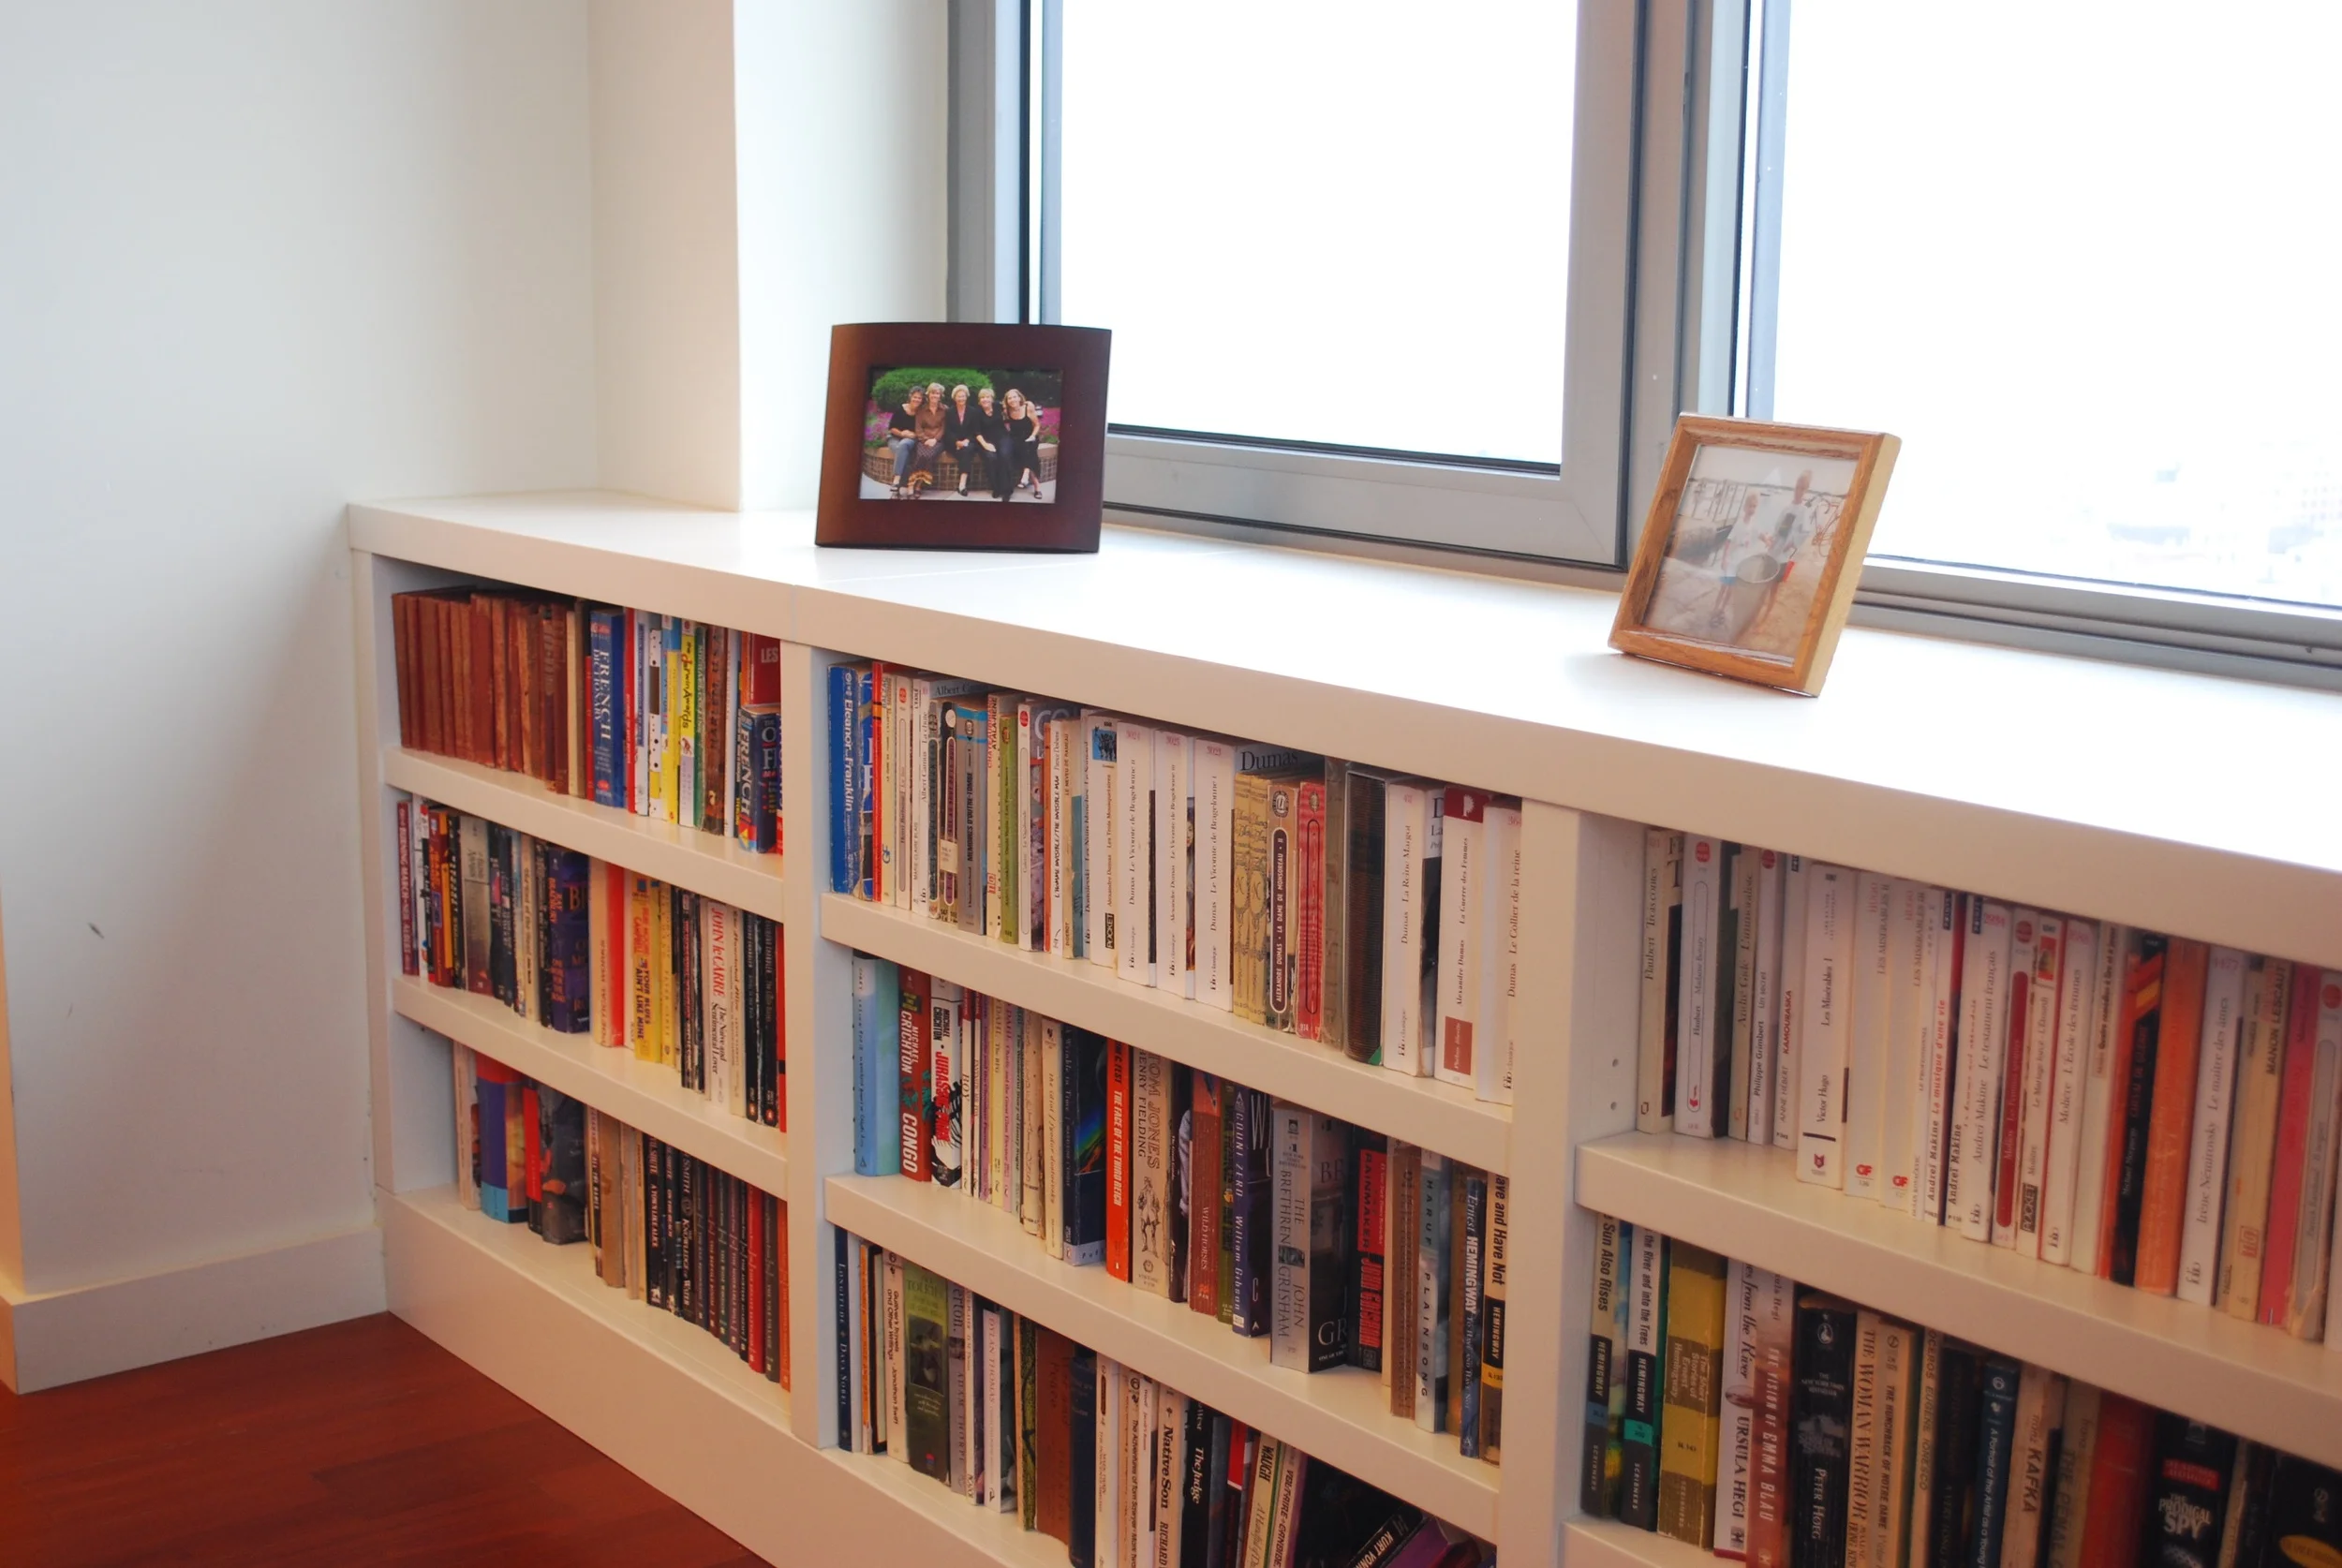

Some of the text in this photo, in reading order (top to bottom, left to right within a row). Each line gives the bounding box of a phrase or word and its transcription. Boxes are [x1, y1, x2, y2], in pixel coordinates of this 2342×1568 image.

[600, 651, 611, 739] FRENCH
[682, 689, 693, 729] Awards
[741, 729, 752, 815] FRENCH
[845, 700, 853, 811] Eleanor Franklin
[1240, 750, 1300, 771] Dumas
[1511, 850, 1520, 875] reine
[1510, 890, 1519, 903] de
[1646, 902, 1657, 928] Trois
[711, 908, 723, 942] JOHN
[1105, 912, 1114, 949] POCKET
[1509, 905, 1519, 939] Collier
[712, 945, 724, 956] le
[1508, 941, 1518, 954] Le
[1644, 937, 1655, 981] Flaubert
[1507, 964, 1517, 998] Dumas
[1758, 971, 1767, 996] secret
[711, 1002, 719, 1049] Sentimental
[719, 1007, 727, 1021] The
[934, 1007, 942, 1041] CRICHTON
[1782, 990, 1793, 1055] KAMOURASKA
[1821, 1012, 1831, 1027] Les
[1936, 999, 1946, 1016] vie
[1979, 998, 1994, 1052] testament
[2265, 965, 2287, 1075] MANON LESCAUT
[900, 1012, 912, 1073] CRICHTON
[1756, 1021, 1765, 1059] Grimbert
[1934, 1020, 1945, 1049] d'une
[1754, 1061, 1764, 1097] Philippe
[1932, 1054, 1945, 1098] musique
[1978, 1055, 1990, 1070] Le
[935, 1052, 950, 1141] JURASSIC PARK
[1114, 1091, 1122, 1105] THE
[1818, 1074, 1830, 1098] Hugo
[1975, 1079, 1988, 1121] Makine
[1114, 1107, 1122, 1126] FACE
[1138, 1097, 1147, 1157] FIELDING
[1148, 1053, 1161, 1169] TOM JONES
[1817, 1100, 1828, 1122] Victor
[1931, 1102, 1940, 1115] La
[903, 1113, 917, 1173] CONGO
[1114, 1128, 1122, 1137] OF
[1929, 1120, 1939, 1160] Makine
[2197, 1192, 2211, 1225] Irène
[2206, 1094, 2219, 1111] Le
[1113, 1180, 1121, 1206] REICH
[1235, 1112, 1243, 1309] COUNT ZERO William Gibson
[1280, 1170, 1291, 1245] BRETHREN
[1295, 1199, 1304, 1224] THE
[2022, 1184, 2037, 1232] POCKET
[1465, 1195, 1478, 1314] Ernest HEMINGWAY
[1597, 1222, 1616, 1311] Sun Also Rises
[837, 1263, 846, 1324] LONGITUDE
[1278, 1266, 1291, 1337] GRISHAM
[1359, 1257, 1381, 1347] JOHN GRISHAM
[1422, 1180, 1433, 1397] HARUF PLAINSONG
[1491, 1203, 1505, 1358] and Have Not HEMINGWAY
[1293, 1284, 1305, 1327] JOHN
[1739, 1280, 1756, 1379] from the River
[1594, 1341, 1606, 1397] HEMINGWAY
[1636, 1357, 1646, 1413] HEMINGWAY
[1758, 1348, 1779, 1521] THE VISION OF EMMA BLAU
[1852, 1330, 1875, 1519] THE WOMAN WARRIOR
[1191, 1447, 1204, 1504] The Judge
[1259, 1444, 1274, 1483] WAUGH
[1732, 1416, 1751, 1518] URSULA HEGI
[1877, 1385, 1895, 1529] THE HUNCHBACK OF NOTRE DAME
[1159, 1425, 1173, 1566] Native Son RICHARD
[1281, 1470, 1294, 1517] VOLTAIRE
[1813, 1468, 1824, 1500] PETER
[2023, 1447, 2042, 1513] KAFKA
[2158, 1498, 2212, 1525] PRODIGAL
[2163, 1514, 2203, 1540] SPY
[1372, 1531, 1393, 1557] KURT
